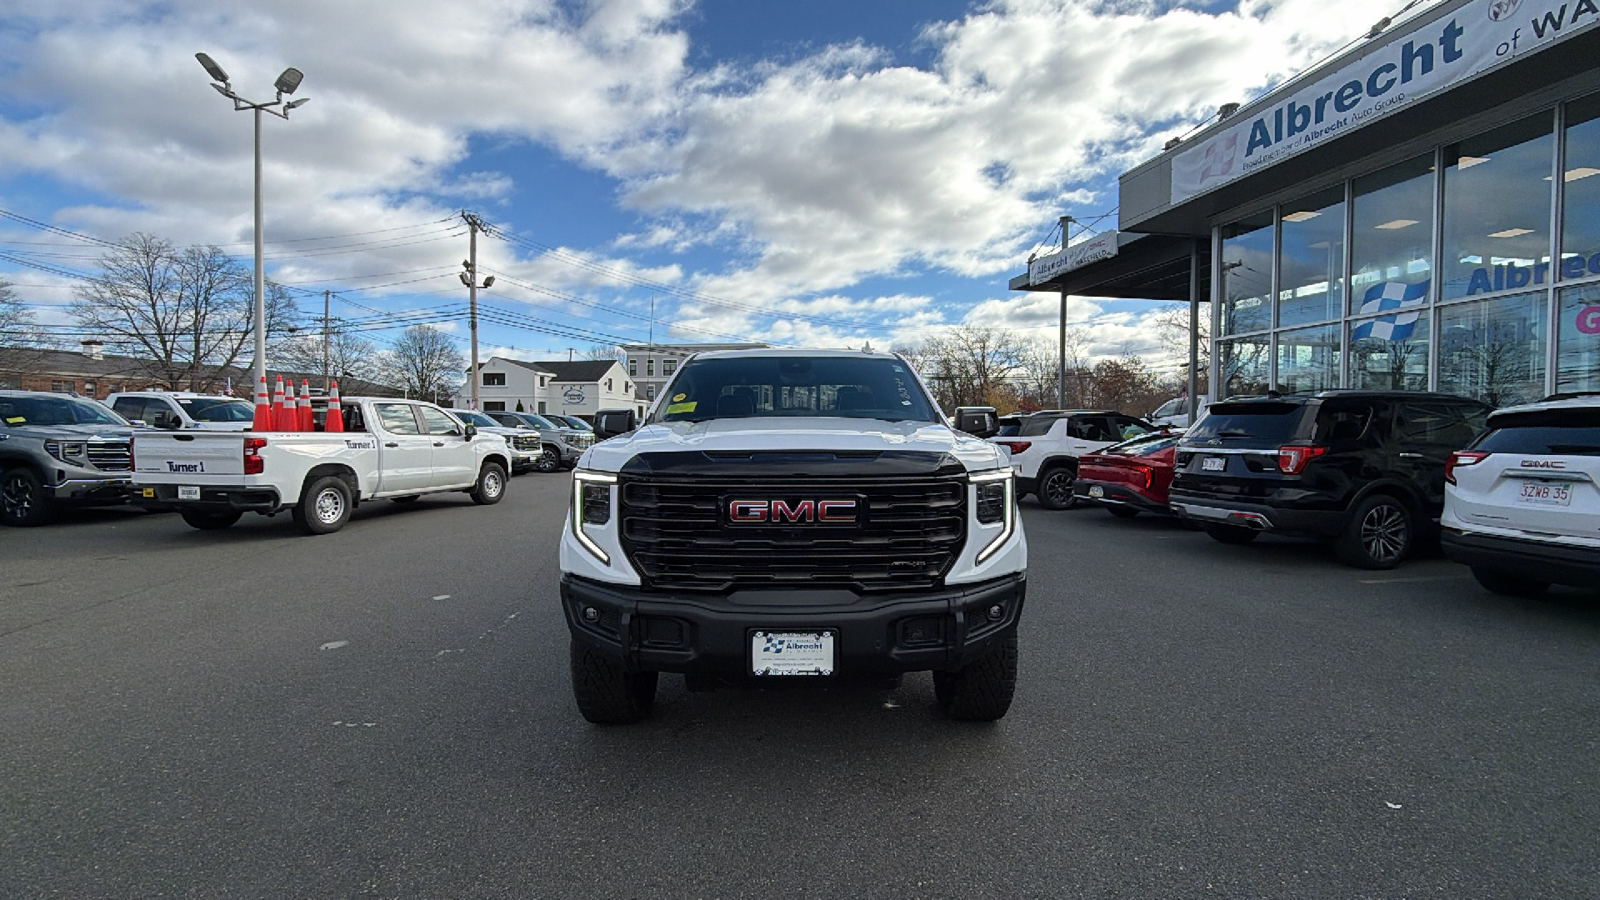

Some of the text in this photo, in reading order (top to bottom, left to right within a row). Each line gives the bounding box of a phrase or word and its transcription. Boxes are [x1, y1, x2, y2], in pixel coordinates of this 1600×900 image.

[1495, 27, 1521, 56] of
[1244, 18, 1464, 158] Albrecht
[1242, 154, 1263, 171] Proud
[1262, 142, 1294, 162] member
[1303, 116, 1348, 144] Albrecht
[1351, 107, 1373, 122] Auto
[1374, 92, 1405, 111] Group
[344, 439, 371, 449] Turner
[166, 461, 205, 472] Turner 1
[1520, 459, 1567, 469] GMC
[1552, 487, 1569, 500] 35
[729, 500, 856, 522] GMC
